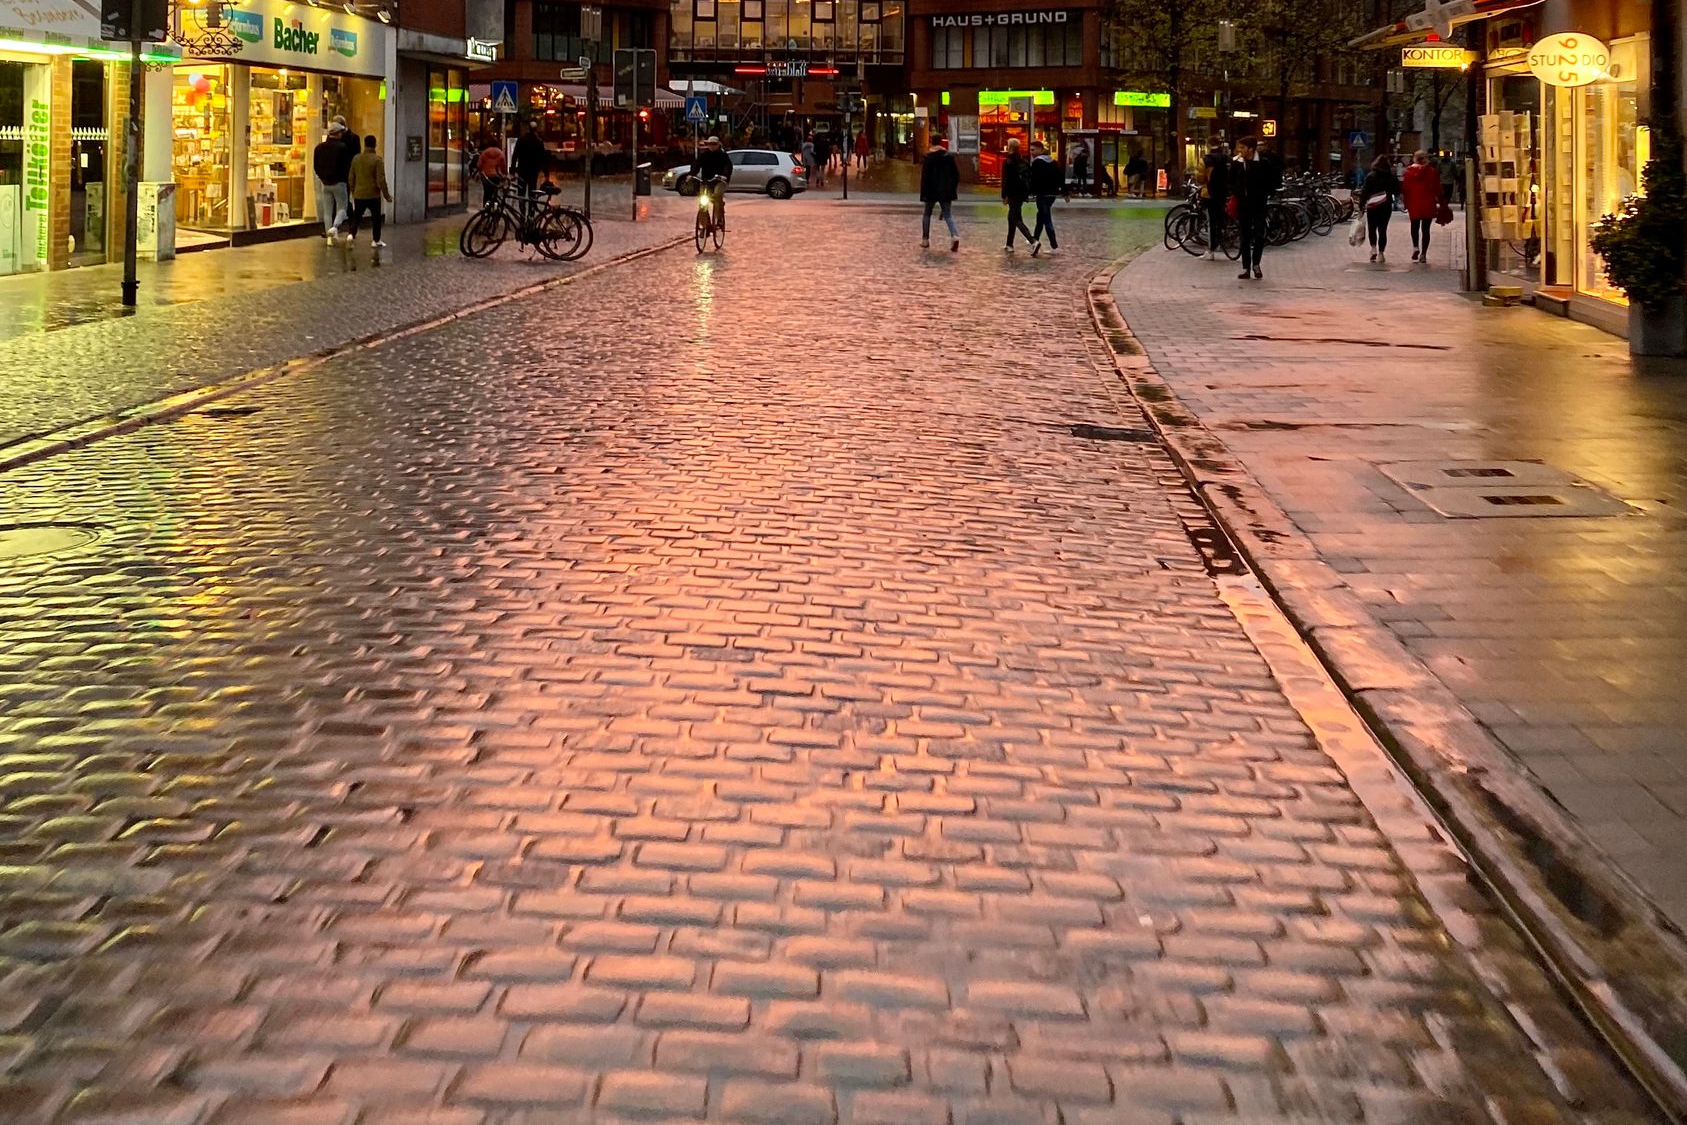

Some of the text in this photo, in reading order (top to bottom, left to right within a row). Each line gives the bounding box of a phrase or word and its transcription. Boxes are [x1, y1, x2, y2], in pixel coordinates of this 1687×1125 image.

[933, 11, 1067, 27] HAUS+GRUND
[274, 17, 319, 55] Bacher
[1402, 49, 1463, 61] KONTOR
[25, 99, 49, 211] Tollkötter
